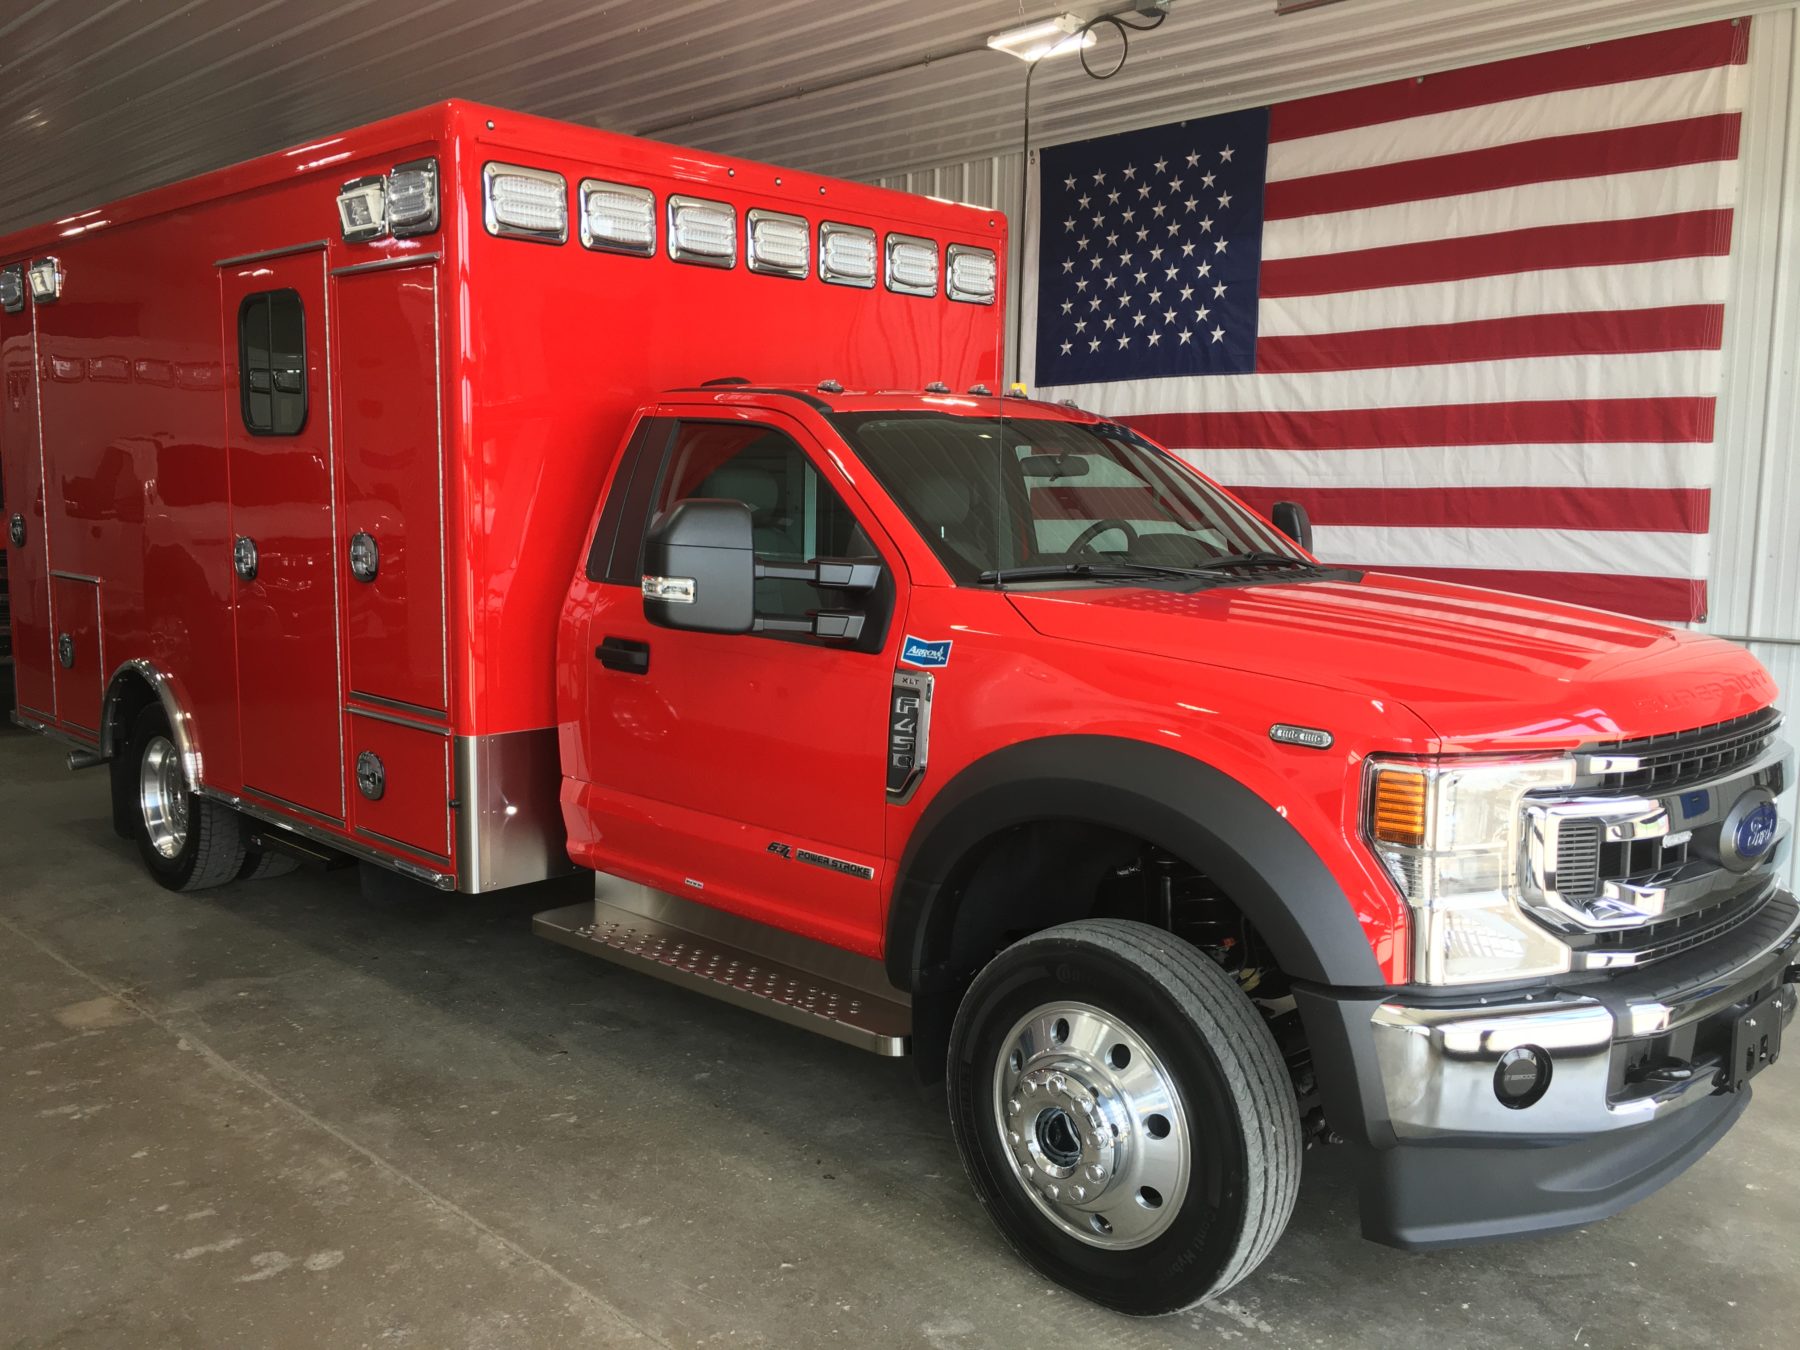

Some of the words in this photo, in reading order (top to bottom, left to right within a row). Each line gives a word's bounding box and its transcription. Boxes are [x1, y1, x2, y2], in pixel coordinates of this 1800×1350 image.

[901, 677, 920, 685] XLT
[1746, 817, 1773, 847] Ford
[797, 849, 830, 865] POWER
[831, 859, 871, 876] STROKE
